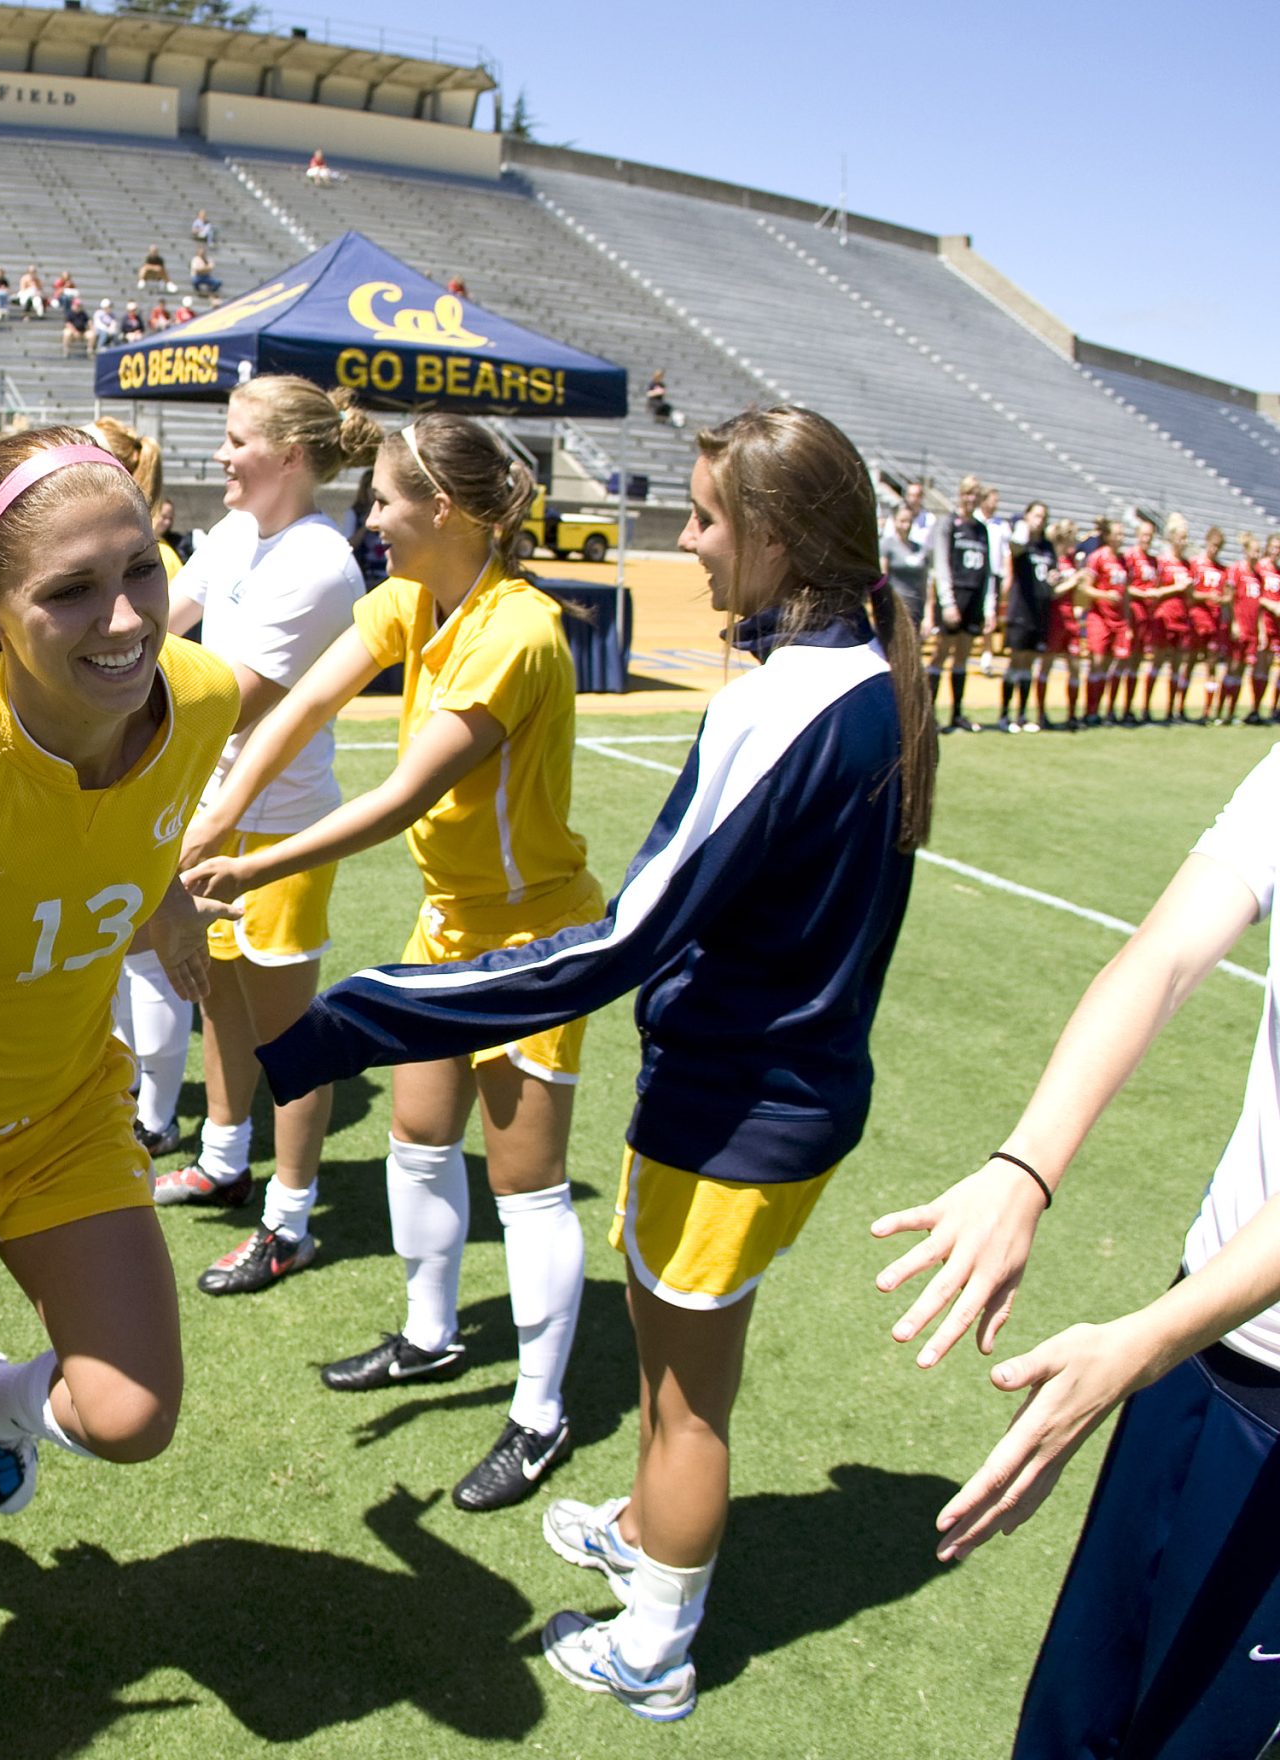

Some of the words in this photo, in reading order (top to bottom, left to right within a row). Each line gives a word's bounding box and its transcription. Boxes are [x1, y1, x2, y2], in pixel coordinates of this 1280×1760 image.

[347, 281, 489, 348] Cal
[118, 352, 146, 390] GO
[147, 344, 220, 386] BEARS!
[335, 347, 404, 391] GO
[415, 354, 566, 405] BEARS!
[153, 794, 190, 849] Cal
[16, 884, 144, 982] 13
